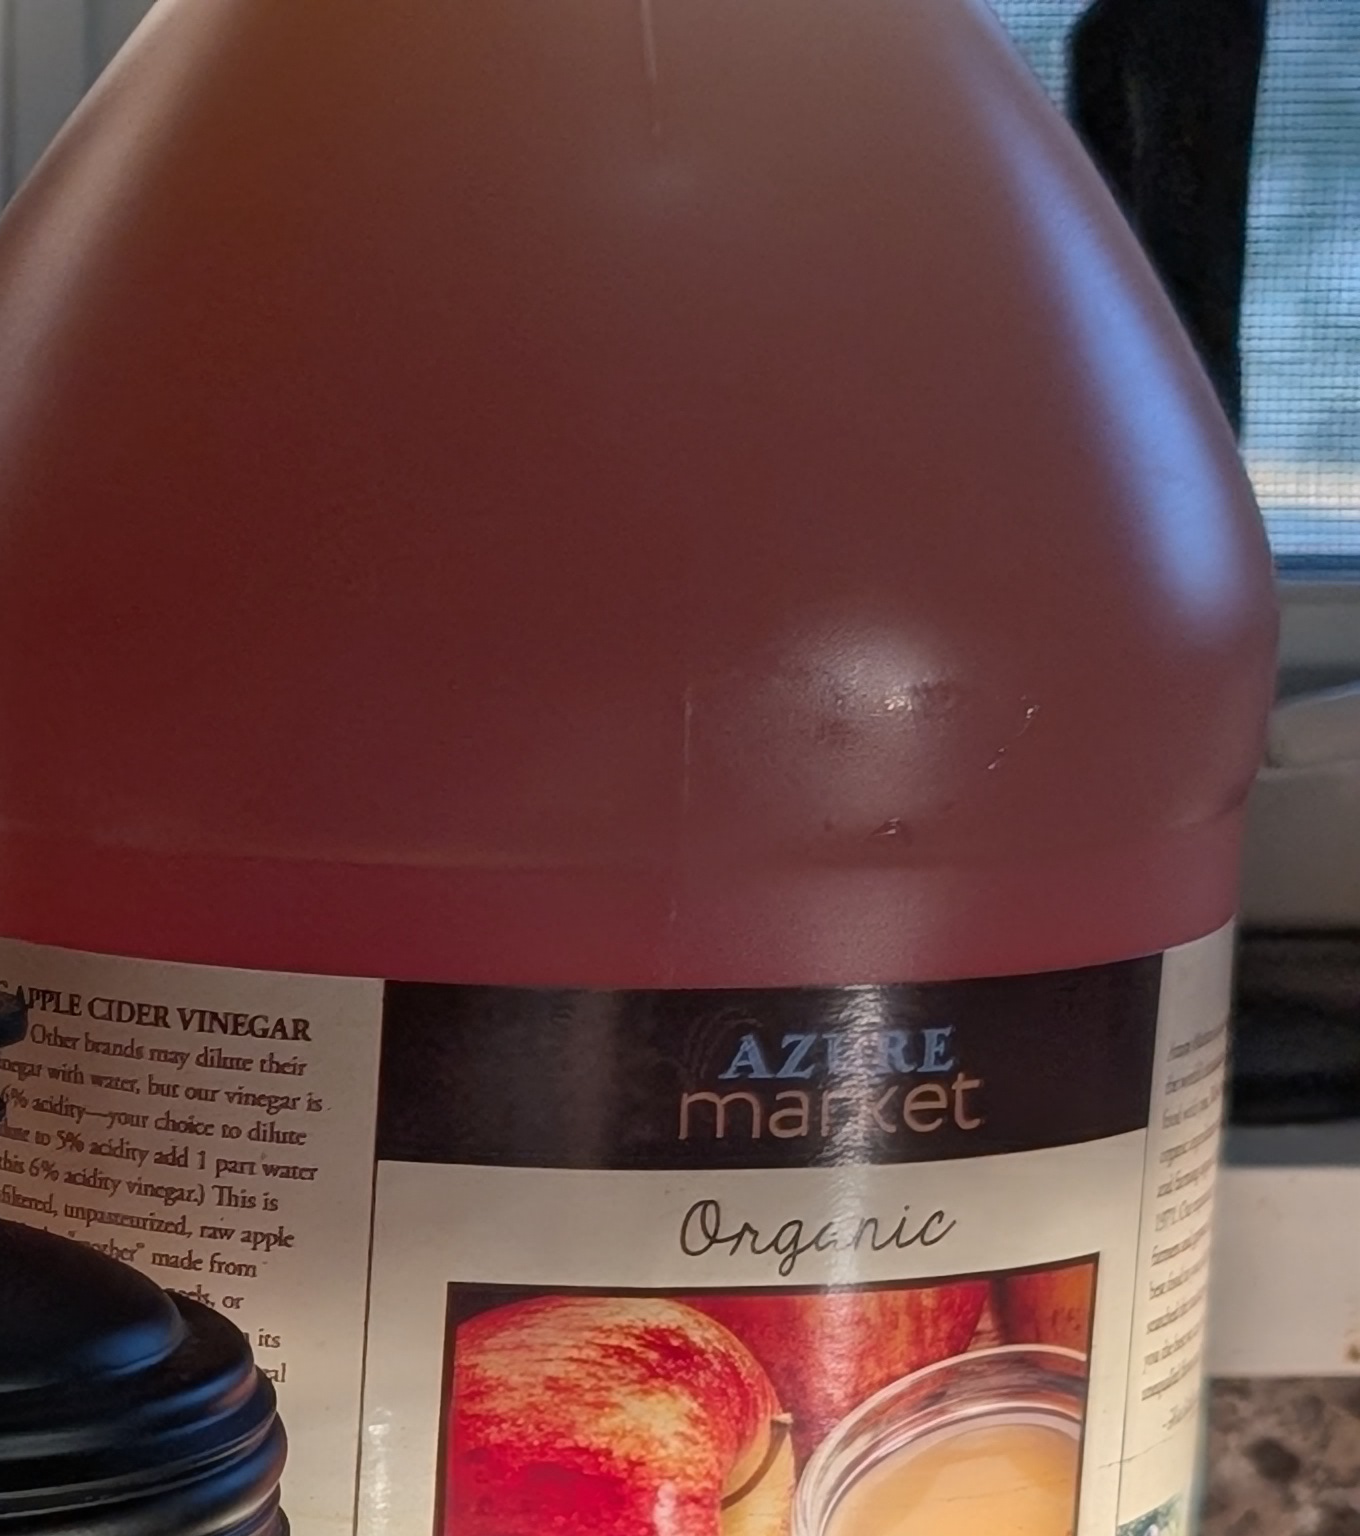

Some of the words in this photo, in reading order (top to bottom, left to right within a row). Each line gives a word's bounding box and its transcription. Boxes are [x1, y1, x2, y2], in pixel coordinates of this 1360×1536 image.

[87, 996, 170, 1028] CIDER
[177, 1007, 312, 1041] VINEGAR
[30, 1023, 80, 1050] Other
[84, 1031, 144, 1060] brands
[148, 1048, 190, 1070] may
[195, 1046, 254, 1072] dilute
[259, 1052, 308, 1076] their
[47, 1063, 84, 1084] with
[91, 1073, 140, 1095] water,
[148, 1074, 180, 1098] but
[184, 1086, 221, 1102] our
[224, 1085, 301, 1116] vinegar
[306, 1092, 324, 1112] is
[678, 1071, 985, 1140] market
[153, 1110, 215, 1136] choice
[221, 1123, 243, 1139] to
[247, 1120, 308, 1146] dilute
[56, 1128, 85, 1153] 5%
[89, 1137, 149, 1168] acidity
[153, 1145, 190, 1168] add
[196, 1149, 207, 1170] 1
[215, 1157, 258, 1179] part
[261, 1162, 319, 1181] water
[28, 1157, 60, 1182] 6%
[63, 1167, 122, 1198] acidity
[211, 1184, 257, 1209] This
[261, 1191, 279, 1212] is
[63, 1202, 194, 1239] unpasteurized,
[198, 1223, 236, 1242] raw
[240, 1226, 296, 1252] apple
[680, 1198, 957, 1278] Organic
[151, 1250, 205, 1272] made
[208, 1252, 258, 1279] from
[221, 1294, 245, 1310] or
[257, 1327, 281, 1350] its
